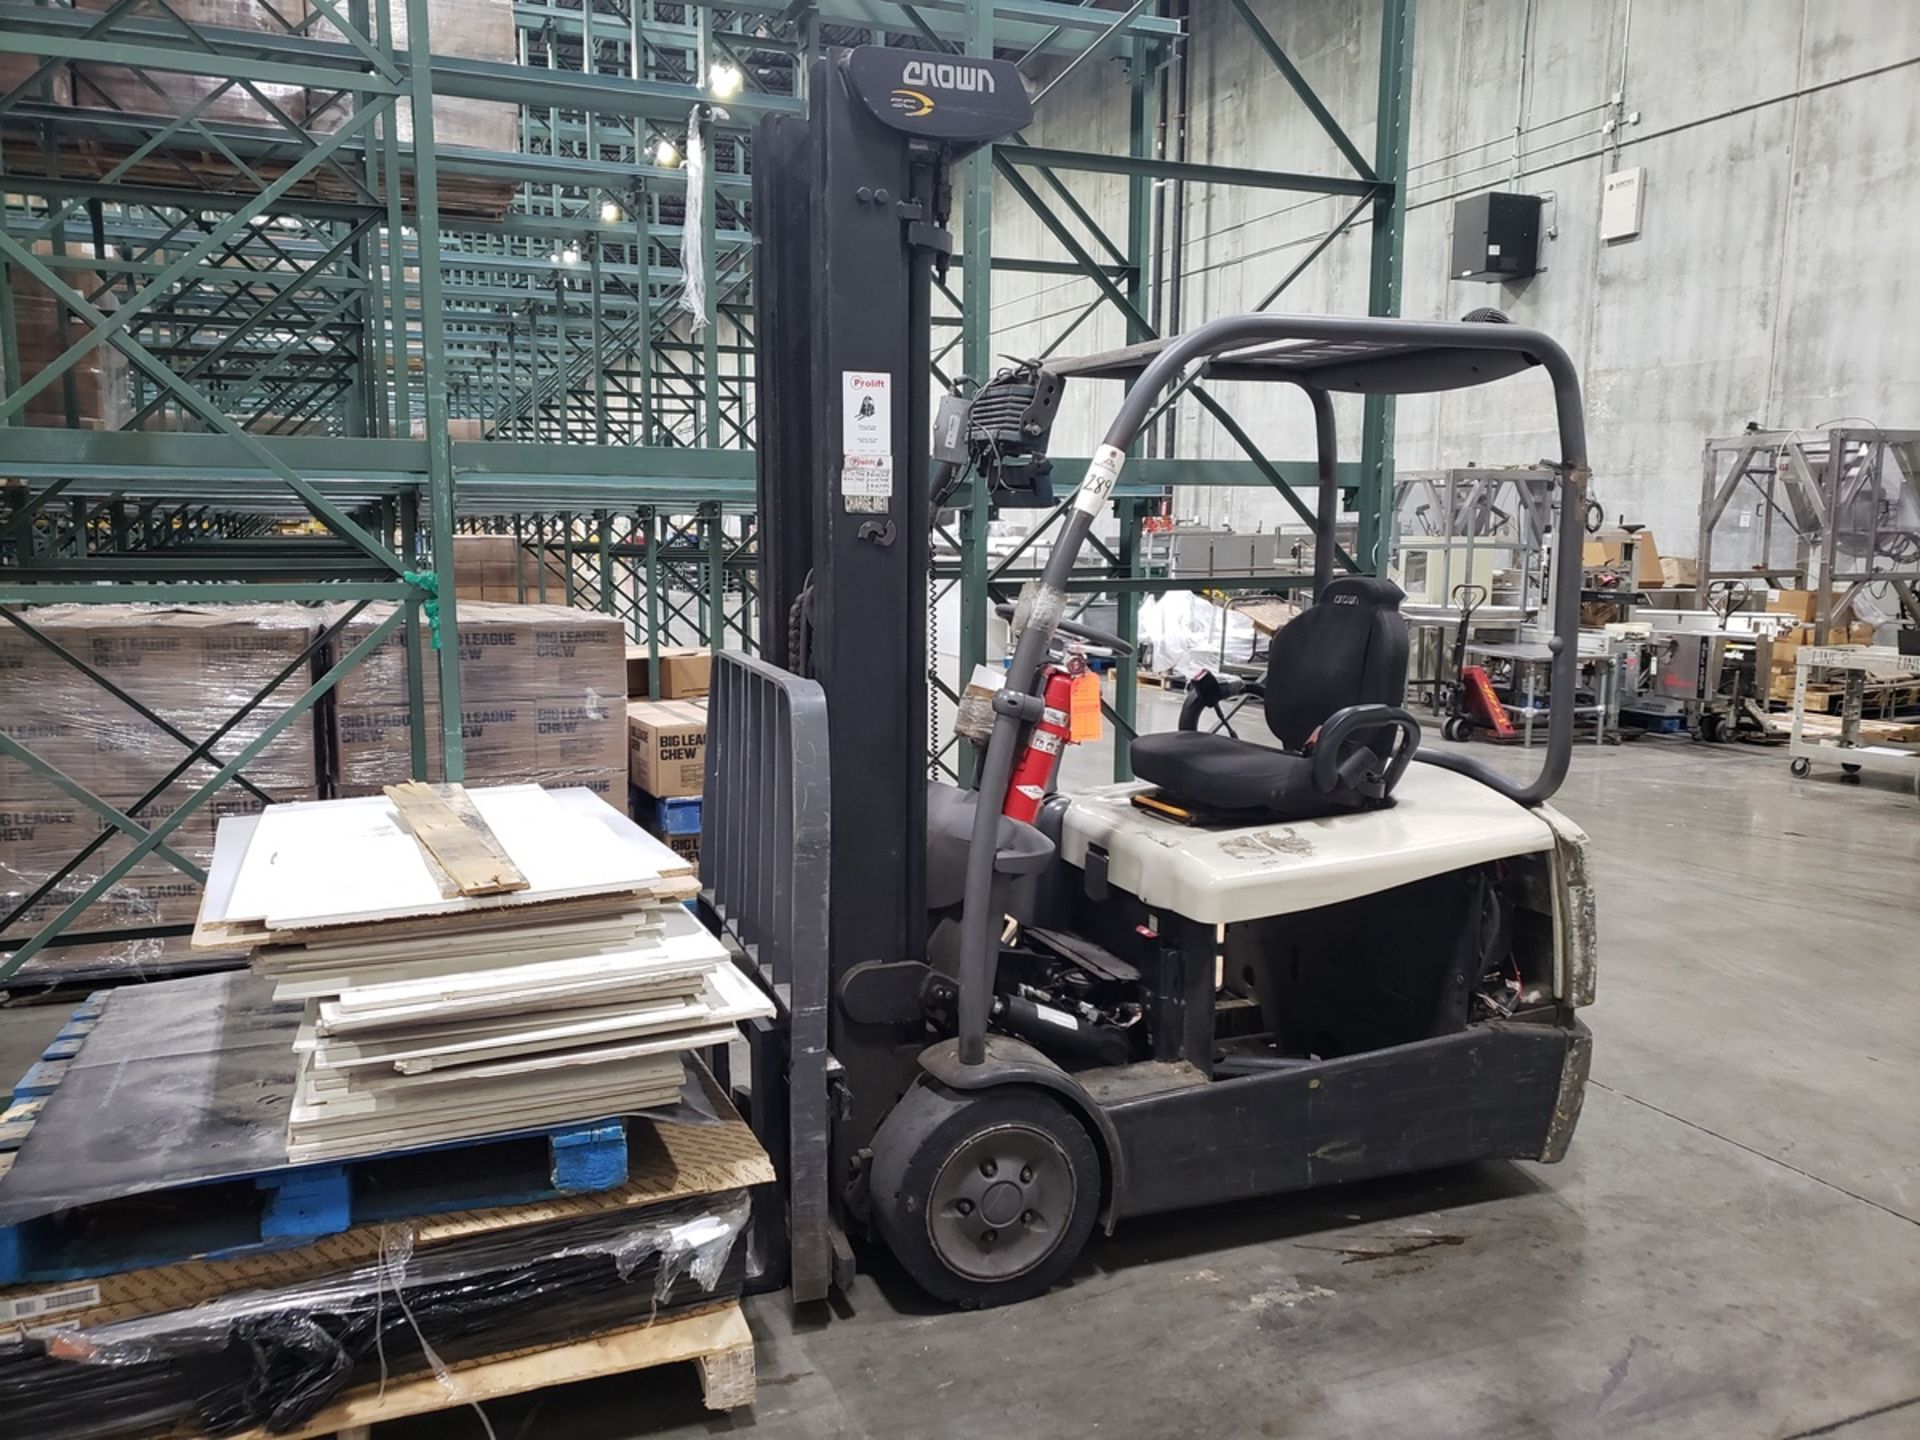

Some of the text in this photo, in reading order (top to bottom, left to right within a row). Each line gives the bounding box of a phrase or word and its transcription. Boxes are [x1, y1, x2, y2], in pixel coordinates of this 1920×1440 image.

[903, 61, 995, 93] CROWN
[853, 379, 885, 388] Prolift
[465, 632, 517, 646] LEAGUE
[467, 709, 517, 723] LEAGUE
[660, 735, 680, 748] BIG
[660, 747, 697, 761] CHEW
